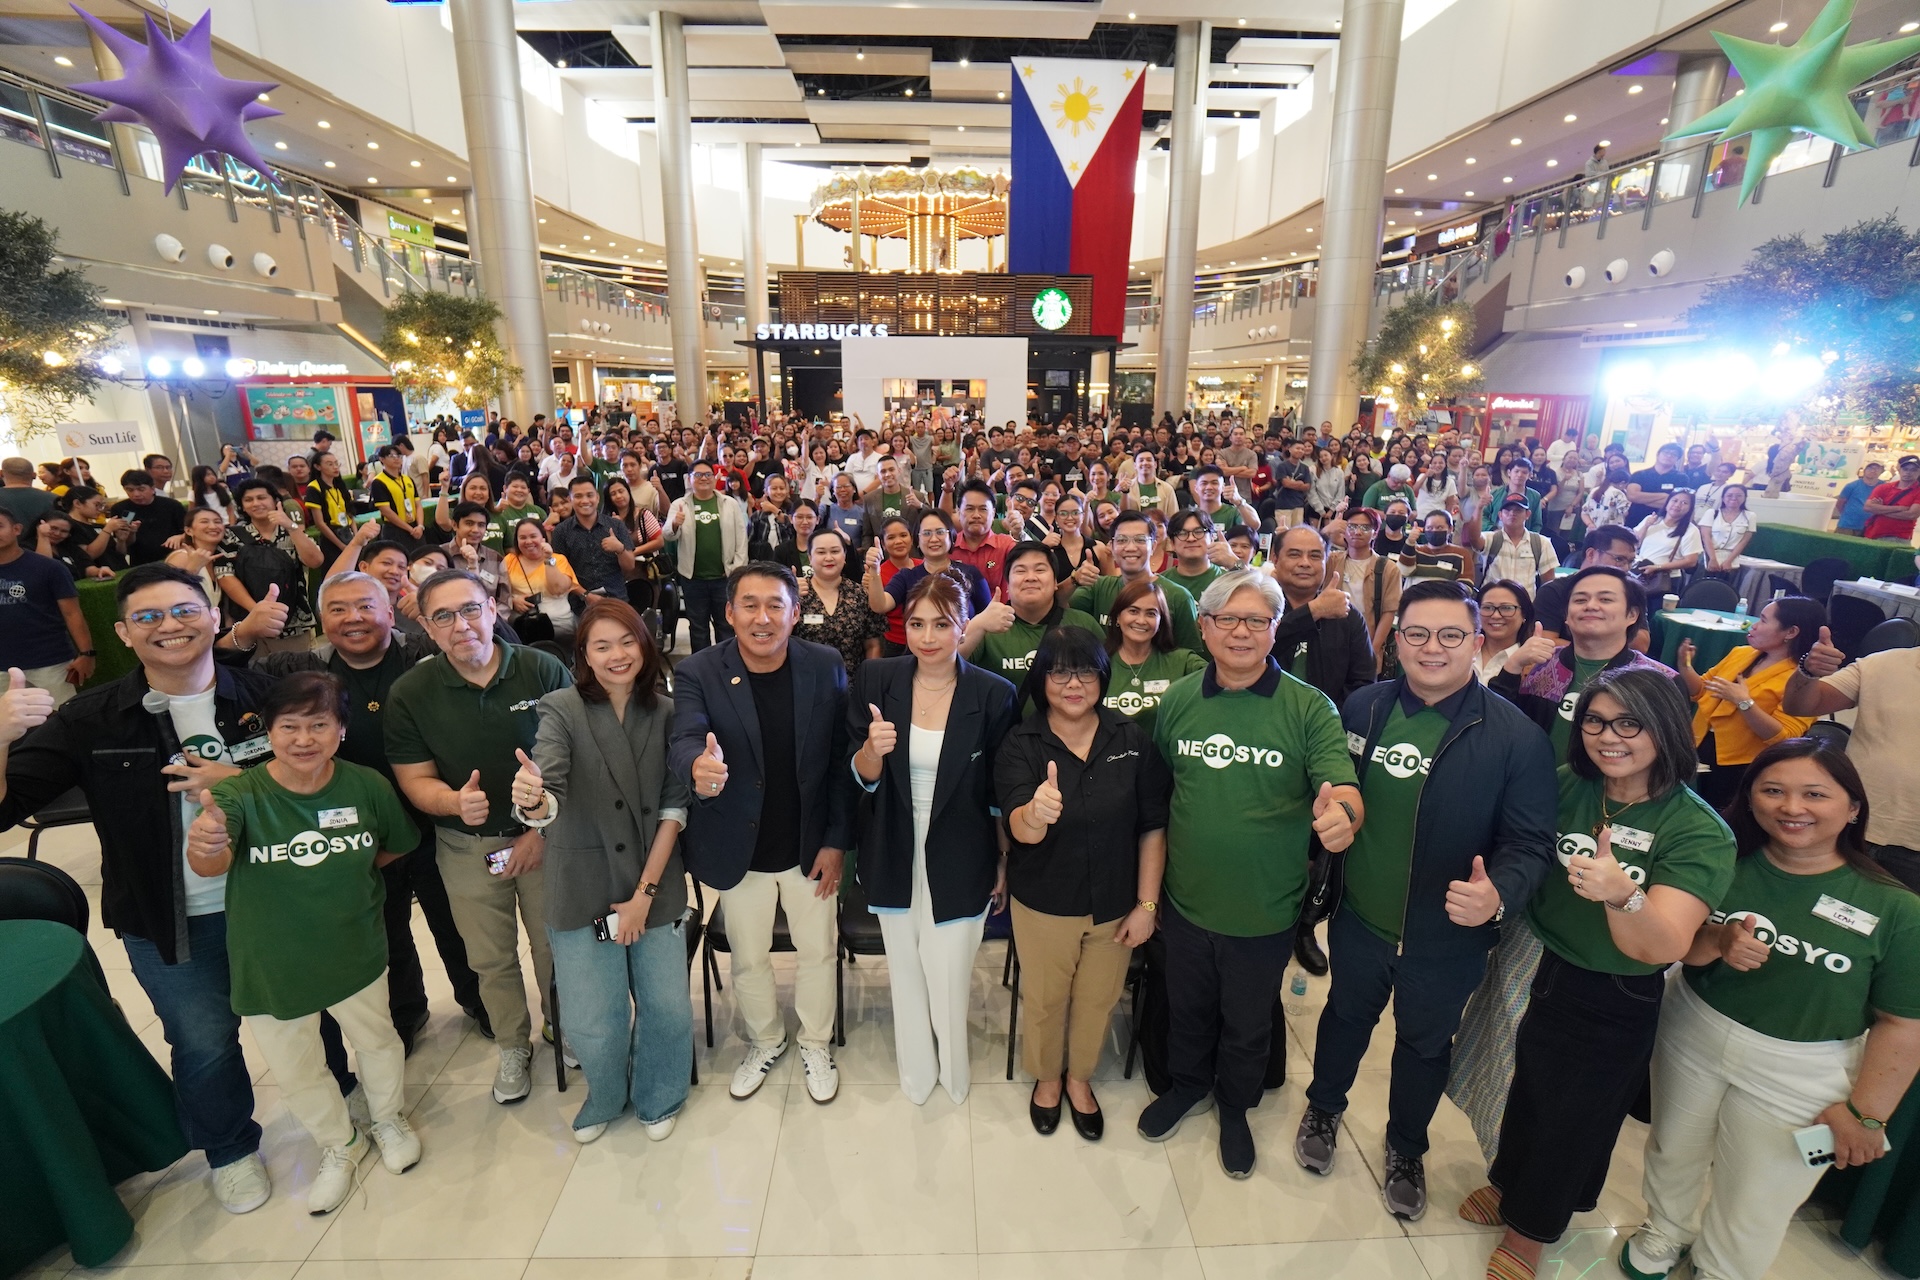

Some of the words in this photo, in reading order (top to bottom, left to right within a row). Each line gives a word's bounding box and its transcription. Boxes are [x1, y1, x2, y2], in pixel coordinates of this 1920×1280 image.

[62, 141, 85, 156] Disney
[86, 149, 107, 160] PIXAR
[756, 323, 889, 341] STARBUCKS
[257, 360, 298, 377] Dairy
[300, 360, 346, 376] Queen
[88, 433, 114, 445] Sun
[115, 431, 137, 444] Life
[290, 510, 302, 521] 12
[243, 746, 266, 757] JORDAN
[1177, 737, 1284, 768] NEGOSYO
[1371, 744, 1433, 776] EGOS
[329, 817, 348, 825] SONIA
[249, 830, 374, 865] NEGOSYO
[1620, 837, 1642, 848] JENNY
[1833, 911, 1856, 926] LEAH
